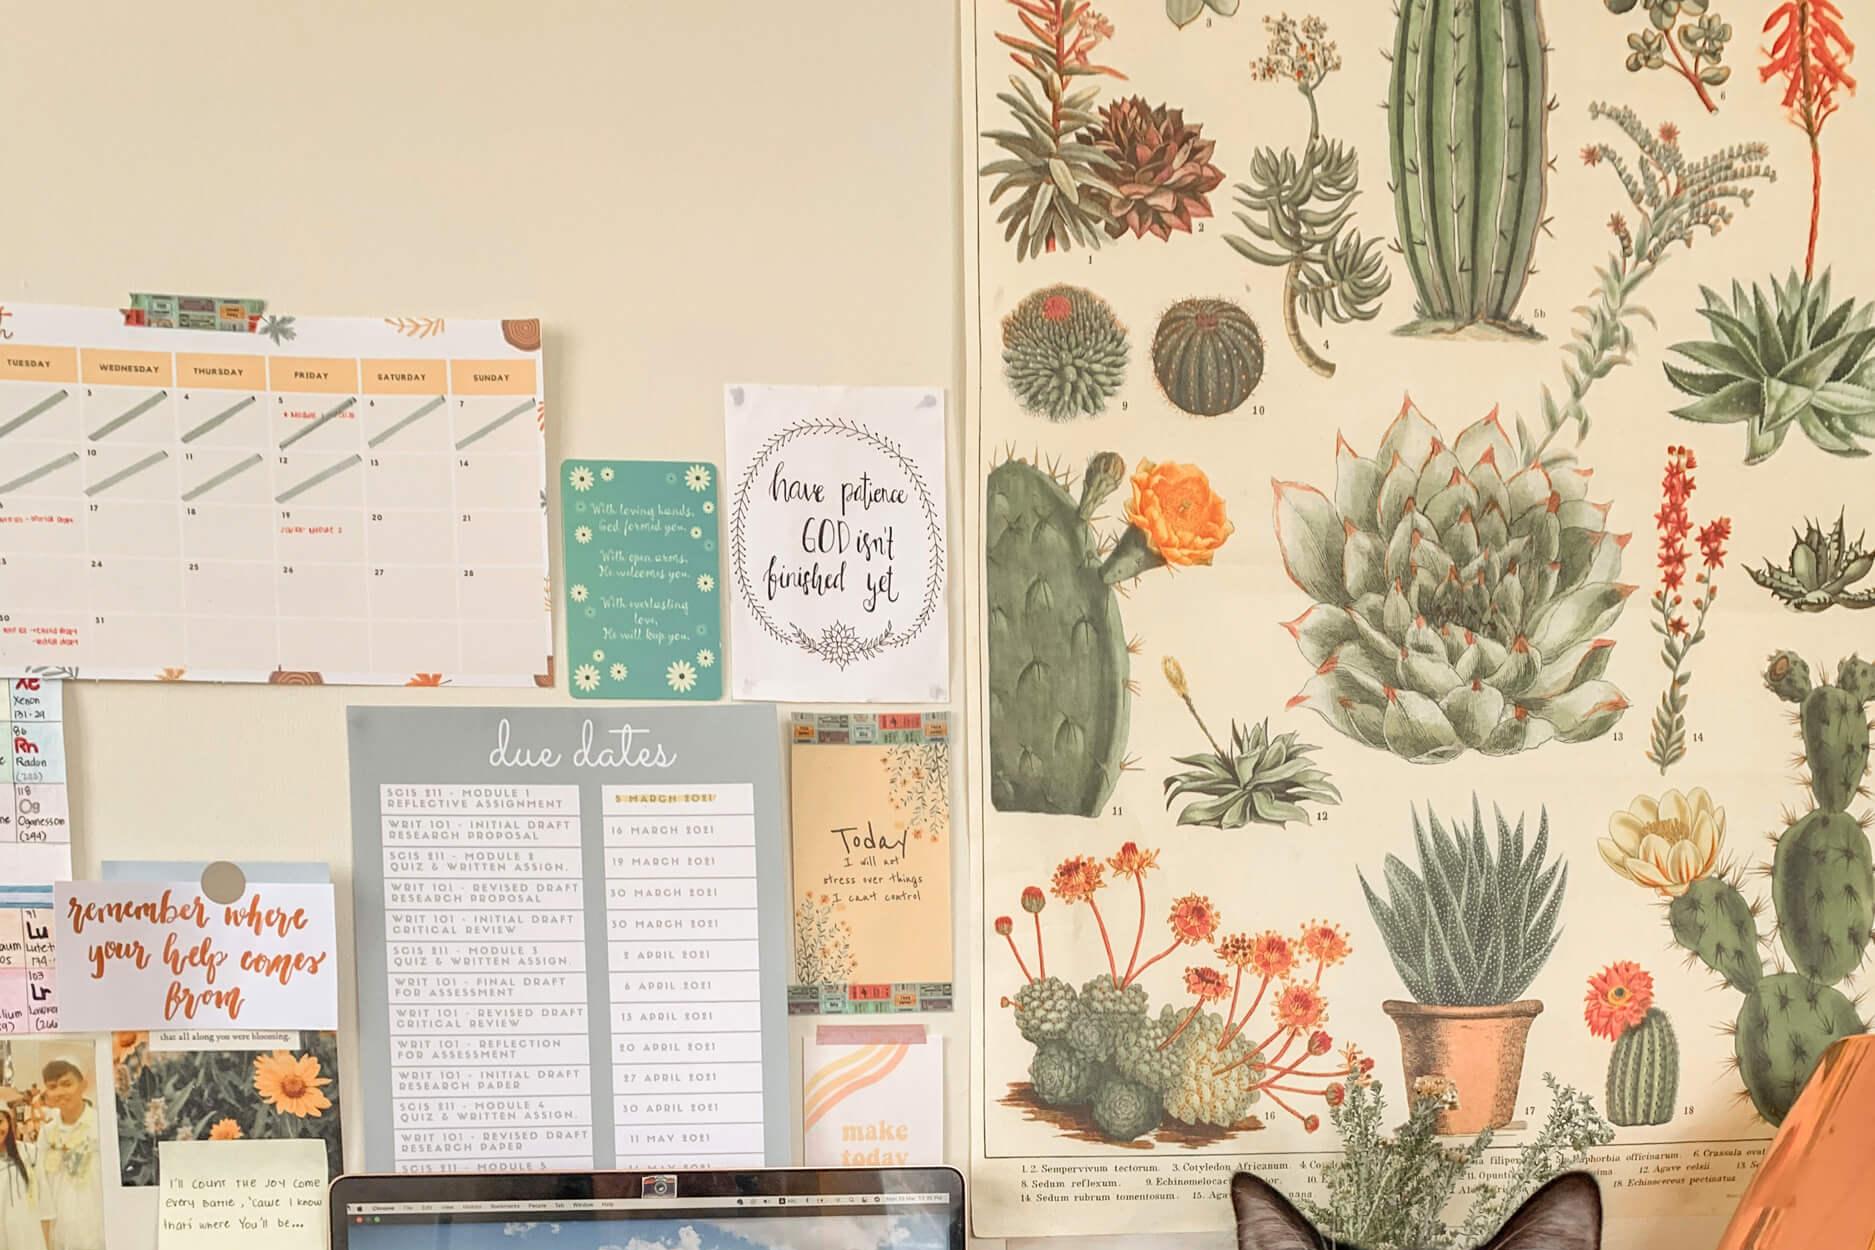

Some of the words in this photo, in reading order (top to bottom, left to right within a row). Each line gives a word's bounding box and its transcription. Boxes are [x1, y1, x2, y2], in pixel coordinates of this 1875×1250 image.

[7, 359, 51, 368] TUESDAY
[100, 363, 159, 374] WEDNESDAY
[193, 367, 244, 377] THURSDAY
[294, 371, 329, 380] FRIDAY
[377, 373, 426, 382] SATURDAY
[473, 374, 510, 382] SUNDAY
[87, 449, 97, 457] 10
[769, 461, 825, 503] have
[840, 471, 908, 516] patience
[801, 516, 851, 554] GOD
[855, 525, 895, 562] isn't
[762, 555, 849, 600] finished
[862, 563, 900, 613] yet
[14, 736, 39, 754] Rn
[489, 718, 562, 768] due
[573, 719, 677, 769] dates
[15, 756, 47, 768] Radon
[462, 788, 518, 798] MODULE
[628, 794, 677, 803] MARCH
[684, 794, 713, 802] 2021
[387, 799, 468, 808] REFLECTIVE
[475, 800, 562, 809] ASSIGNMENT
[388, 820, 422, 829] WRIT
[430, 820, 450, 829] 101
[470, 820, 520, 829] INITIAL
[527, 820, 571, 829] DRAFT
[611, 826, 623, 835] 16
[631, 826, 678, 835] MARCH
[686, 825, 714, 834] 2021
[389, 831, 460, 840] RESEARCH
[468, 831, 539, 841] PROPOSAL
[830, 820, 908, 859] Today
[843, 857, 853, 867] I
[860, 855, 876, 867] will
[883, 856, 899, 865] not
[390, 863, 424, 872] QUIZ
[447, 863, 506, 871] WRITTEN
[823, 873, 856, 885] stress
[863, 876, 883, 885] over
[889, 871, 924, 888] things
[473, 883, 528, 892] REVISED
[536, 883, 579, 892] DRAFT
[832, 892, 842, 903] I
[884, 889, 921, 901] control
[68, 889, 209, 933] remember
[224, 893, 309, 938] where
[26, 921, 49, 940] Lu
[393, 925, 457, 934] CRITICAL
[465, 925, 516, 934] REVIEW
[89, 939, 151, 979] your
[163, 932, 228, 984] help
[240, 951, 327, 985] comes
[637, 951, 675, 960] APRIL
[682, 950, 710, 959] 2021
[395, 988, 420, 997] FOR
[429, 988, 514, 997] ASSESSMENT
[164, 980, 245, 1021] from
[160, 1031, 176, 1041] that
[178, 1031, 190, 1041] all
[192, 1031, 215, 1042] along
[216, 1034, 231, 1042] you
[479, 1040, 562, 1049] REFLECTION
[624, 1074, 636, 1083] 27
[644, 1073, 681, 1082] APRIL
[689, 1072, 717, 1081] 2021
[399, 1081, 470, 1090] RESEARCH
[478, 1081, 521, 1090] PAPER
[1524, 1105, 1536, 1115] 17
[1683, 1105, 1695, 1115] 18
[842, 1120, 909, 1141] make
[647, 1134, 674, 1143] MAY
[682, 1134, 710, 1142] 2021
[1041, 1164, 1108, 1174] Sempervivum
[1182, 1163, 1231, 1173] Cotyledon
[1031, 1180, 1065, 1188] Sedum
[1036, 1193, 1069, 1202] Sedum
[1074, 1193, 1111, 1201] rubrum
[199, 1219, 231, 1230] where
